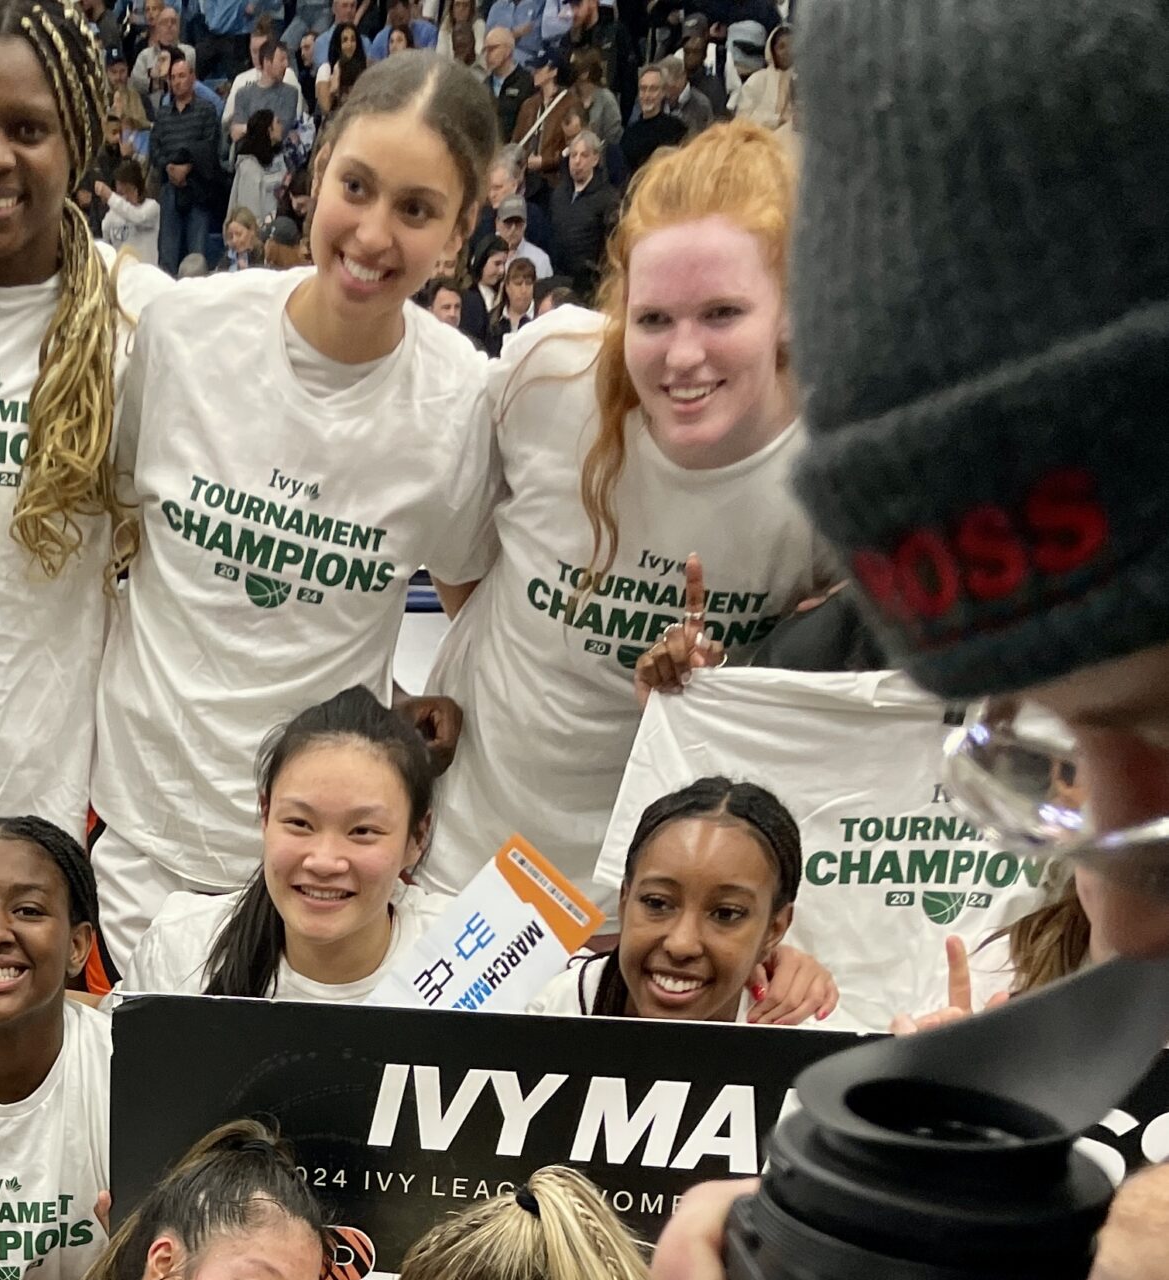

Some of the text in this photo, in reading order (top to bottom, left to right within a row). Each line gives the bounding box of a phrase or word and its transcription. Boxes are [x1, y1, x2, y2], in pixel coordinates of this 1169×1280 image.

[268, 469, 303, 497] Ivy
[190, 475, 387, 552] TOURNAMENT
[161, 500, 395, 593] CHAMPIONS
[638, 550, 674, 576] Ivy
[216, 563, 322, 603] 20 24
[557, 560, 769, 613] TOURNAENT
[587, 641, 609, 654] 20
[888, 892, 990, 907] 20 24
[367, 1063, 569, 1157] IVY
[365, 1171, 416, 1197] IVY
[431, 1176, 516, 1200] LEAG
